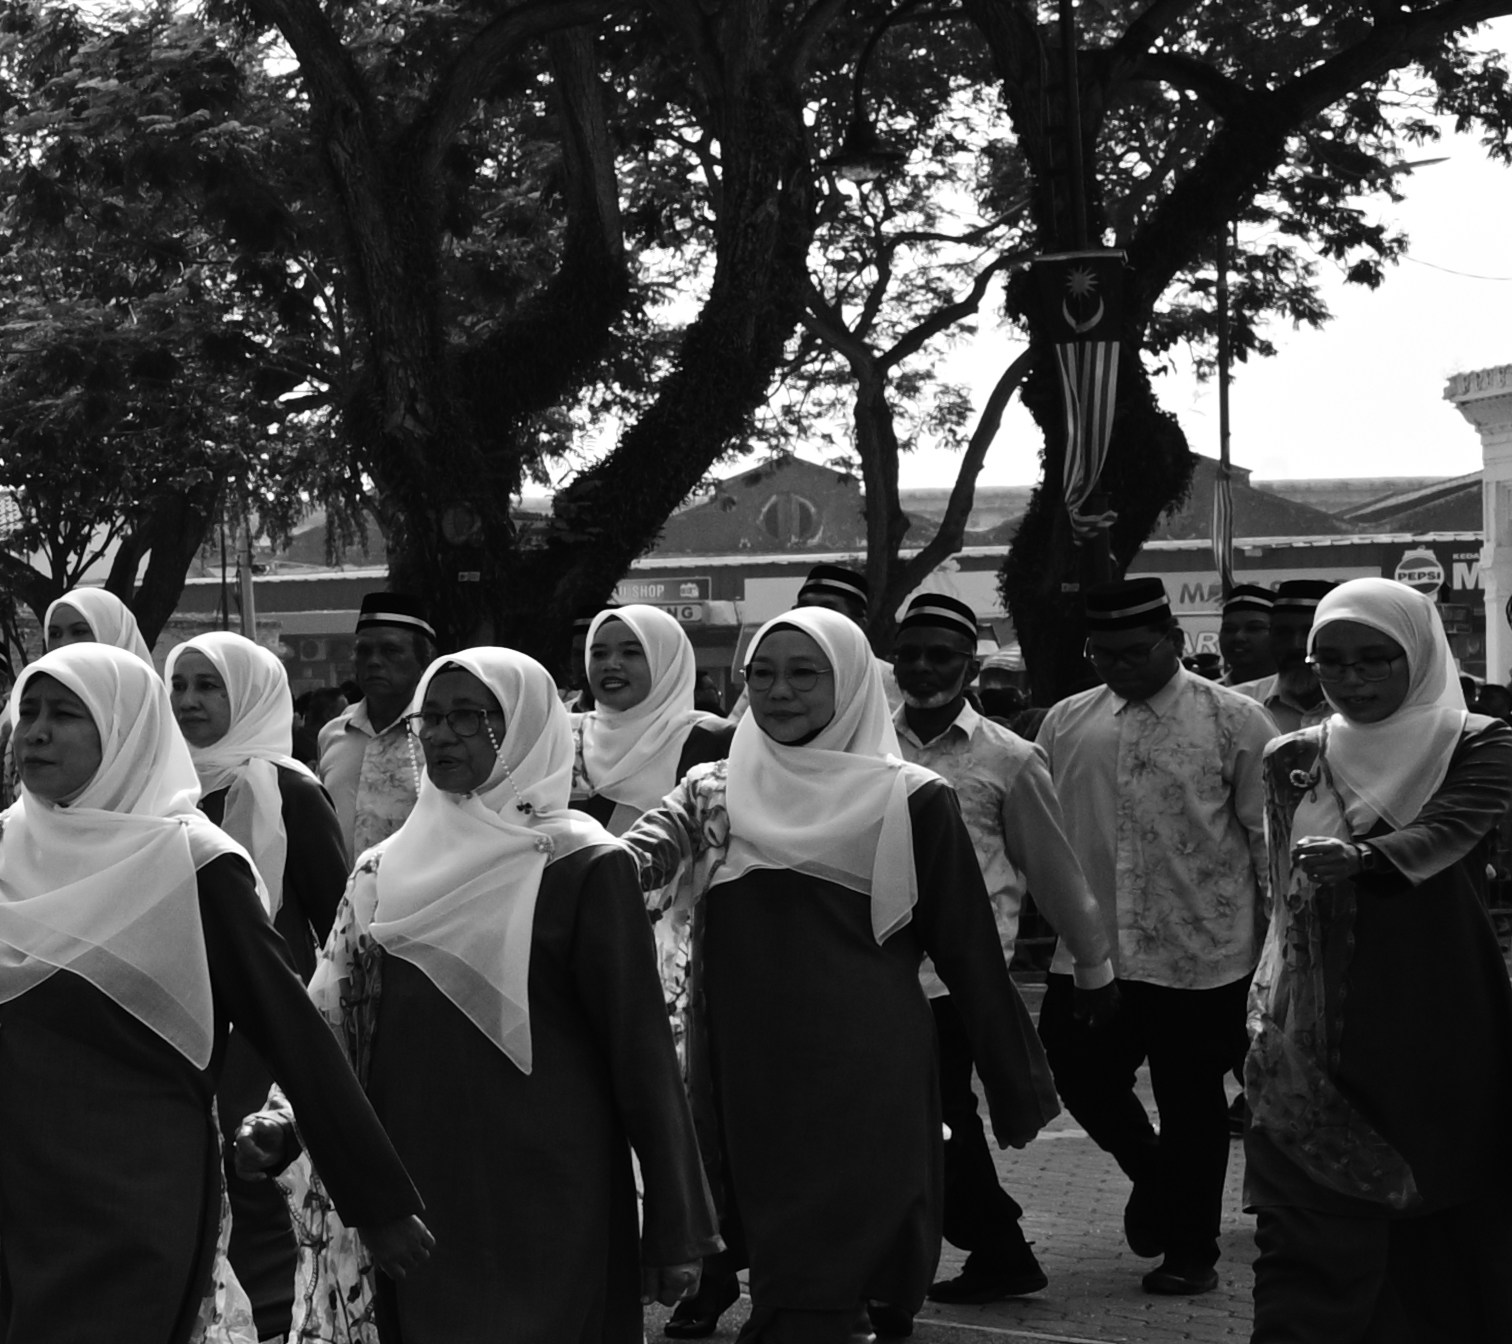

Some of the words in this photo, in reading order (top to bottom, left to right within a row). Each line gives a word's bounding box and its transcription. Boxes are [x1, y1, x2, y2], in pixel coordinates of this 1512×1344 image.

[1452, 552, 1480, 561] KEDA
[1398, 571, 1441, 581] PEPSI
[1452, 561, 1485, 590] M
[632, 584, 665, 597] SHOP
